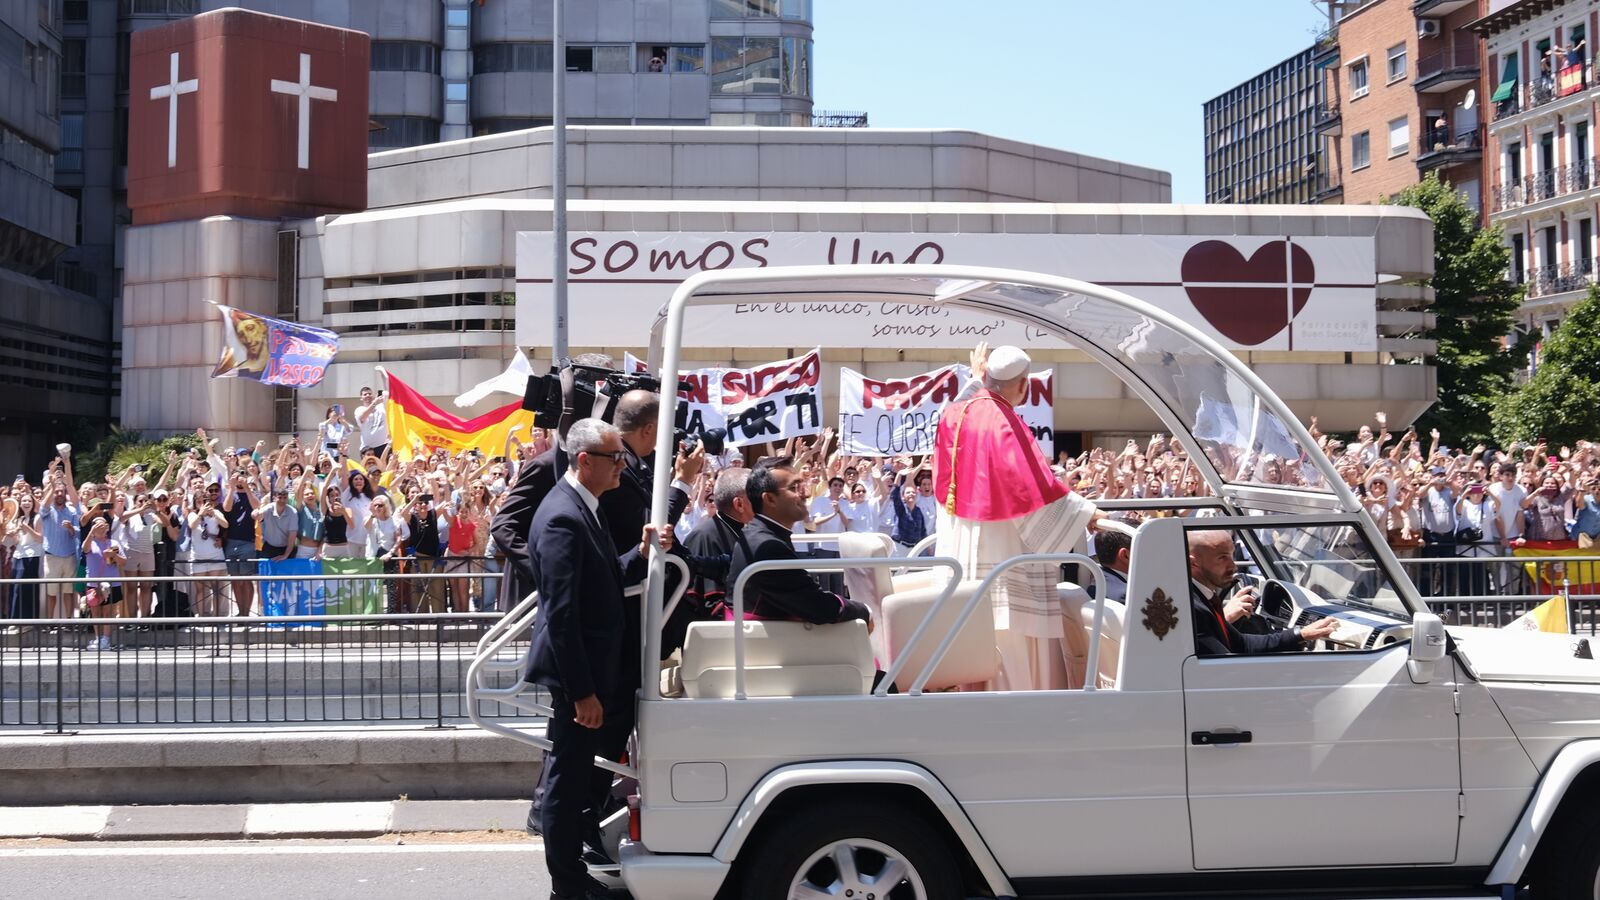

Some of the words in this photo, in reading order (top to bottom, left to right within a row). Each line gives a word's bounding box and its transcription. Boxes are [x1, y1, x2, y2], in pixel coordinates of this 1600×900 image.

[735, 302, 767, 314] En
[872, 323, 941, 337] somos
[727, 400, 780, 443] POR
[839, 412, 865, 454] TE
